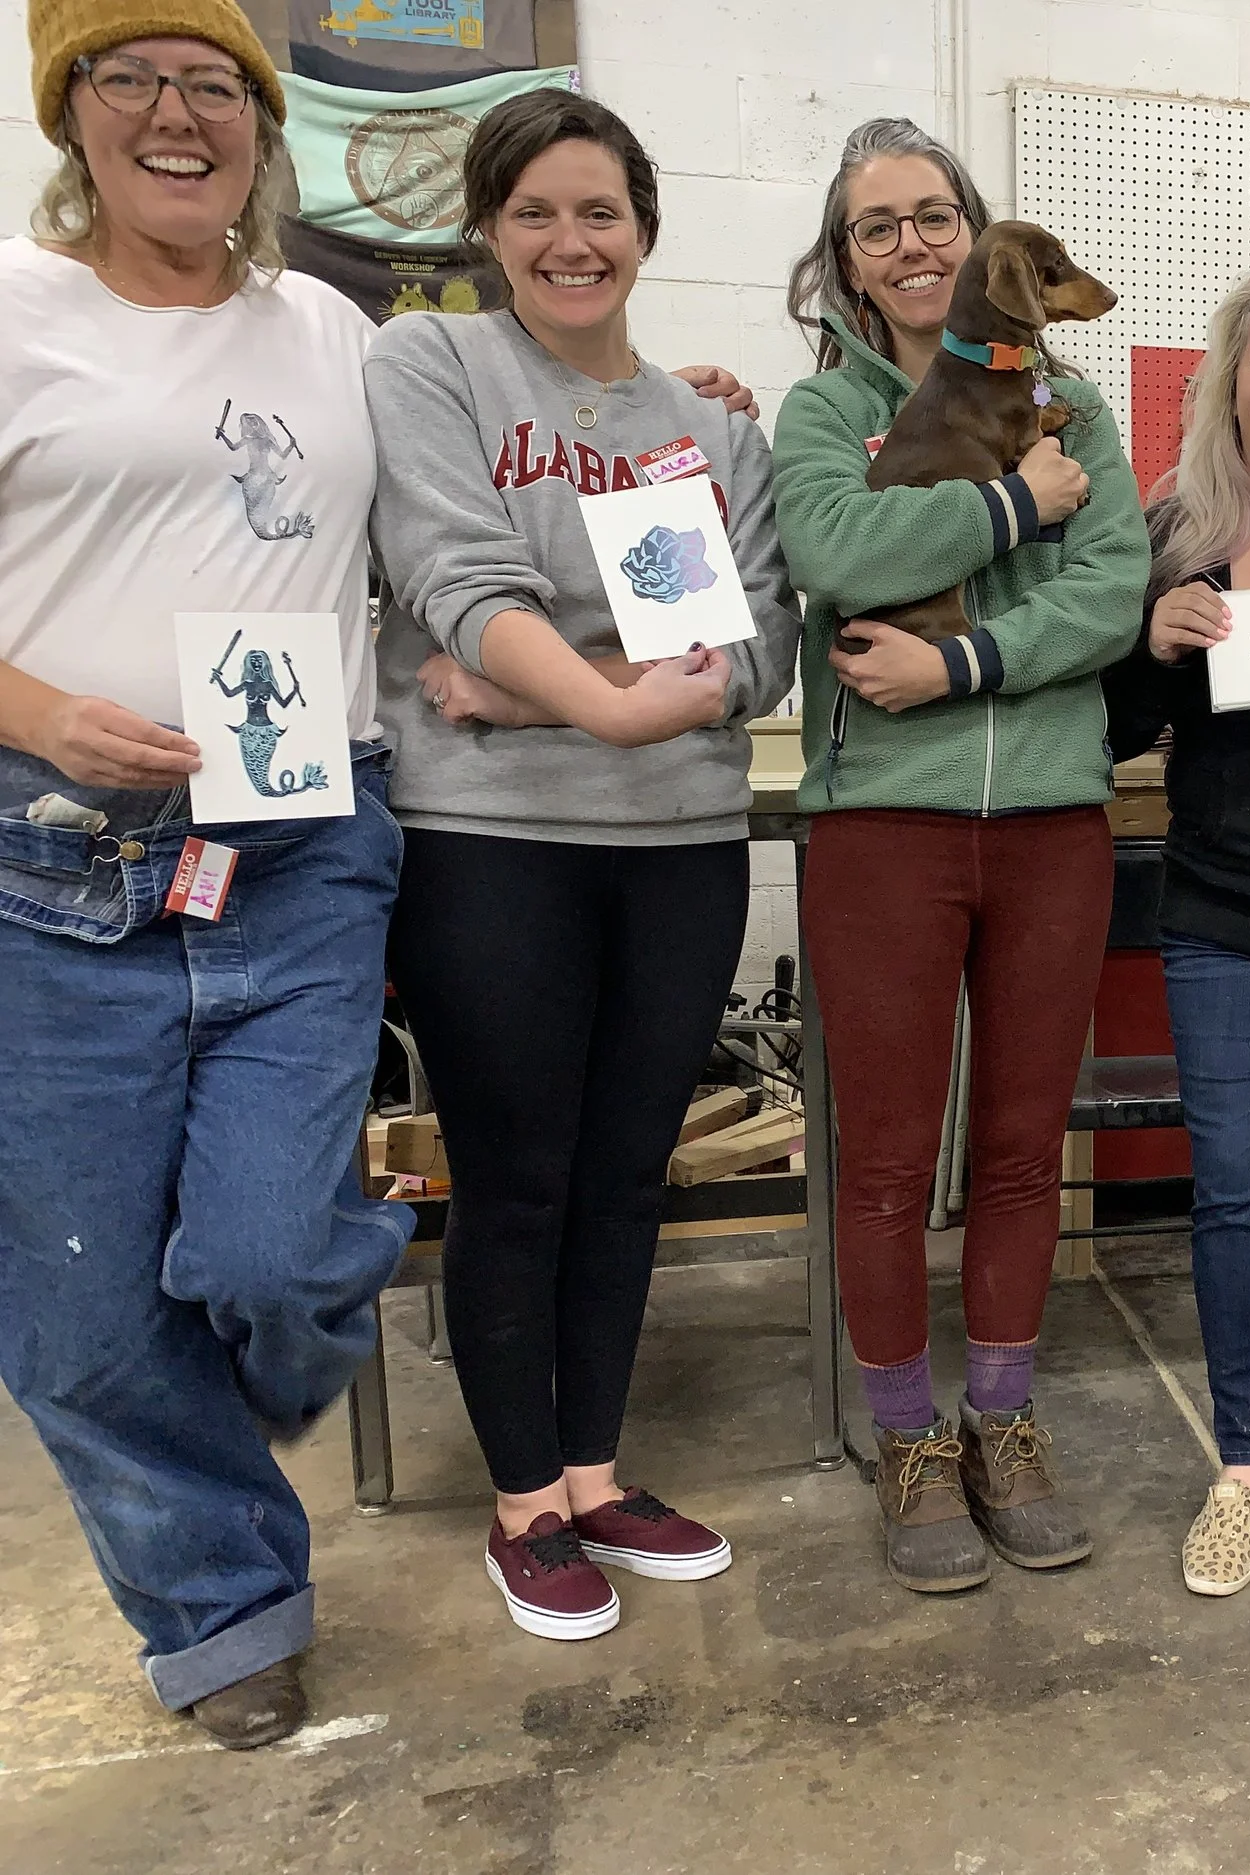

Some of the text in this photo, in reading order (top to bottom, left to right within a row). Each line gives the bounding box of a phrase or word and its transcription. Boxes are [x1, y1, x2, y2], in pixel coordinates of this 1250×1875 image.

[405, 8, 456, 19] LIBRARY
[390, 261, 436, 271] WORKSHOP
[648, 442, 682, 460] HELLO
[174, 853, 196, 896] HELLO
